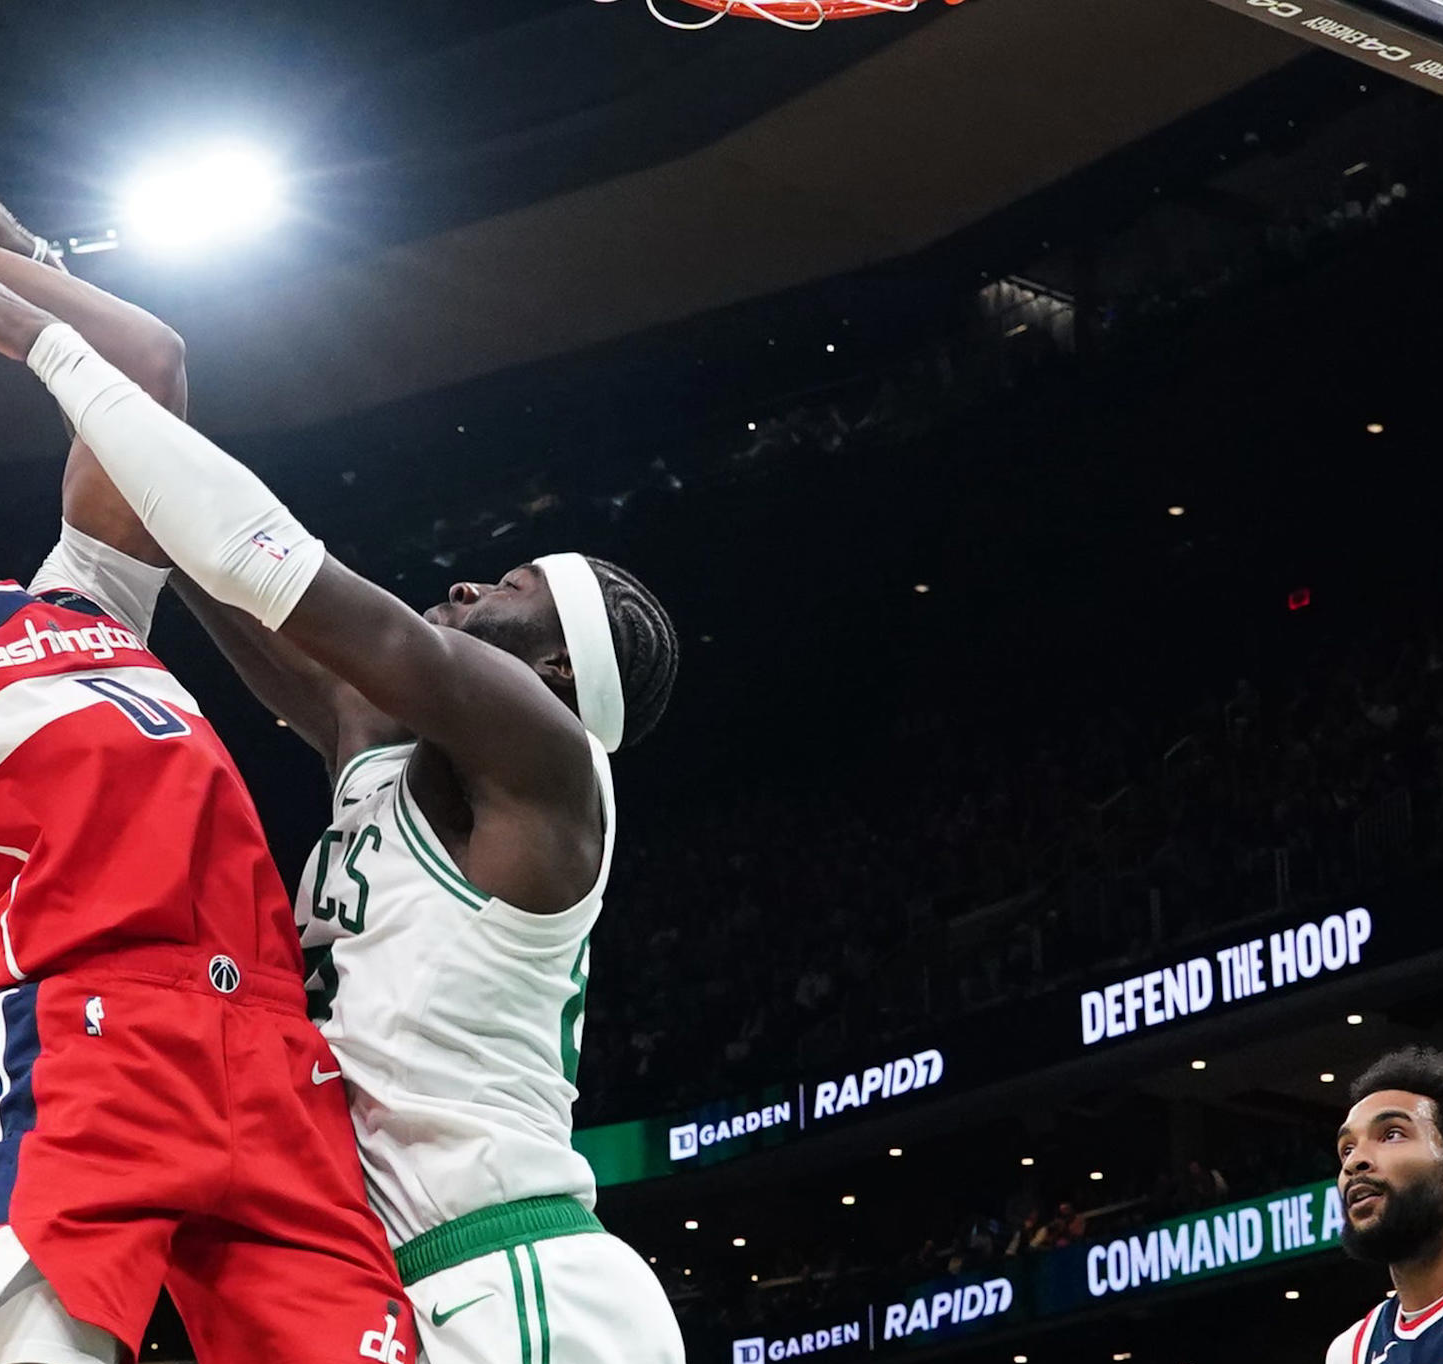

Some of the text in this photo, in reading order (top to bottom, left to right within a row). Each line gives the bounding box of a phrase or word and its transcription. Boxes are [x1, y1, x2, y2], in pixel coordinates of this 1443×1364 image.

[1302, 16, 1365, 44] ENERGY
[1080, 906, 1372, 1045] DEFEND THE HOOP
[699, 1101, 791, 1146] GARDEN
[1087, 1206, 1263, 1297] COMMAND
[1267, 1192, 1316, 1253] THE
[768, 1320, 860, 1361] GARDEN
